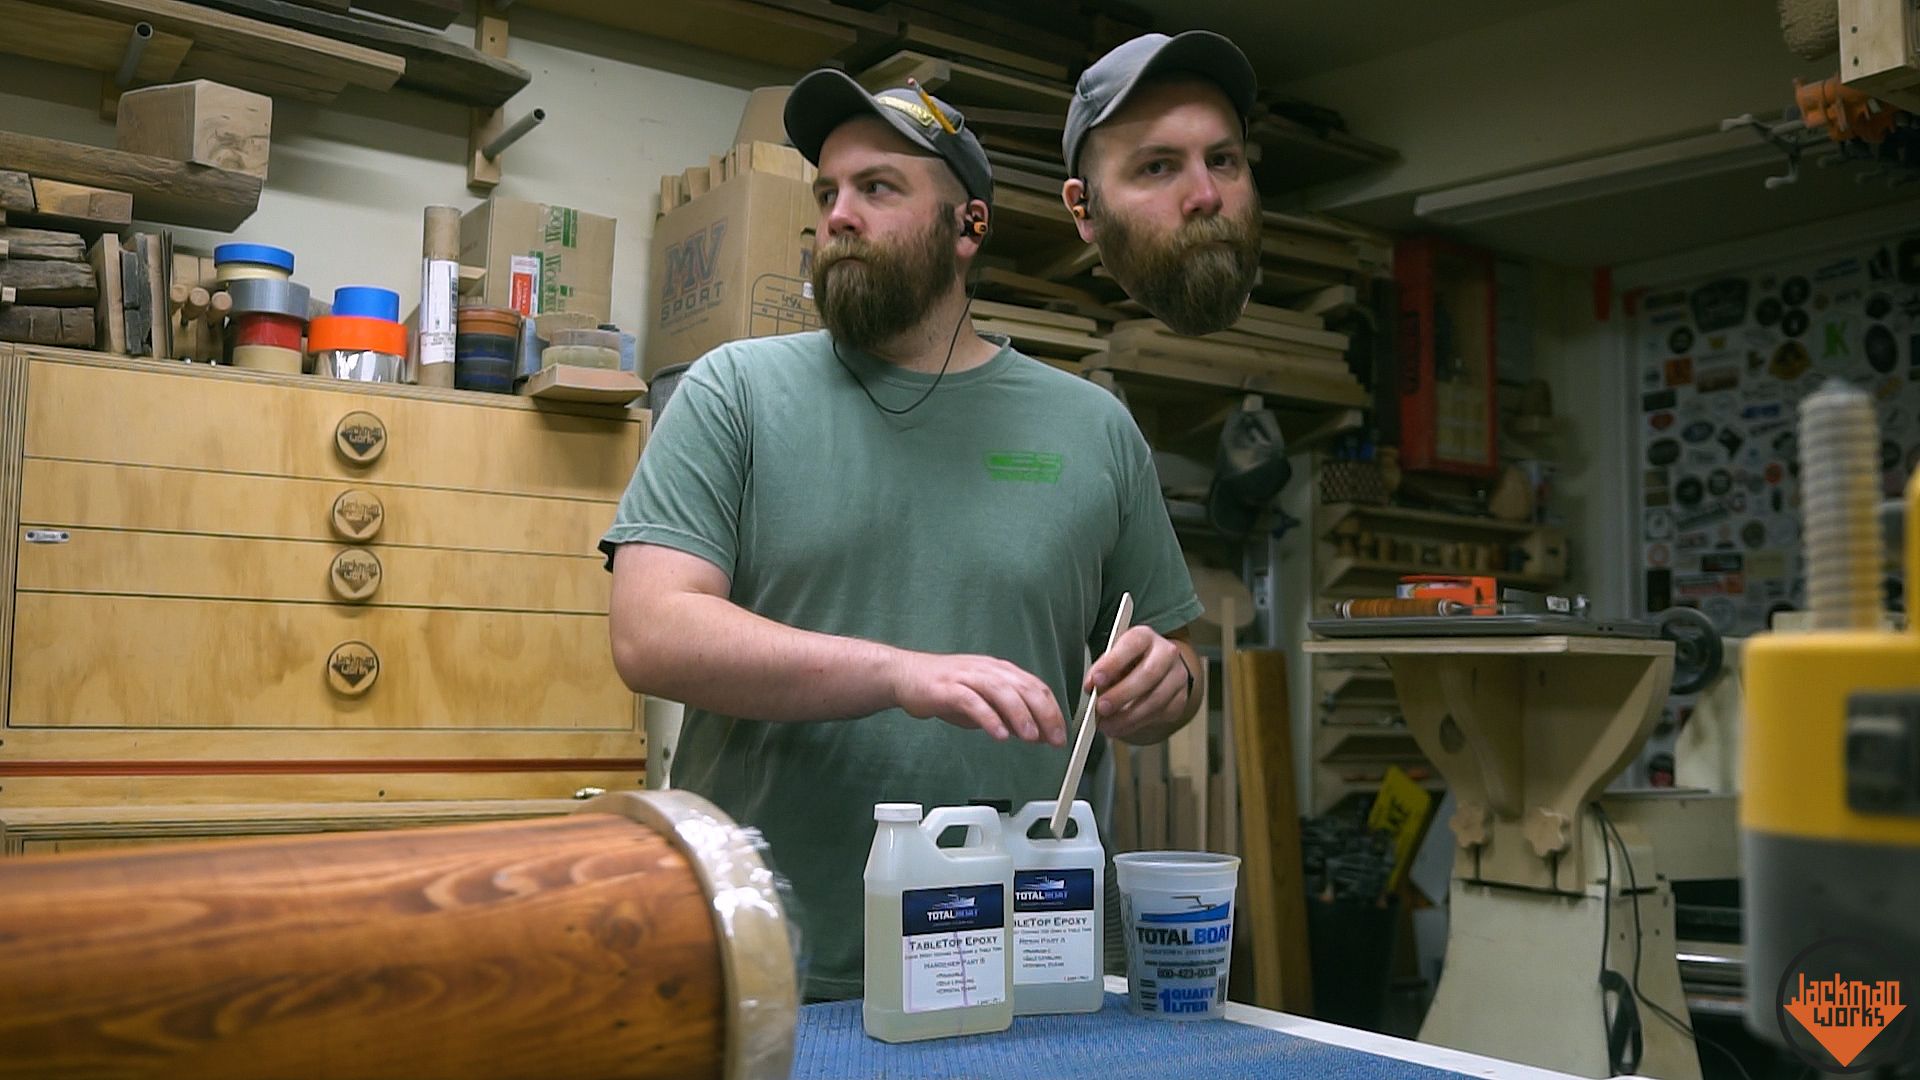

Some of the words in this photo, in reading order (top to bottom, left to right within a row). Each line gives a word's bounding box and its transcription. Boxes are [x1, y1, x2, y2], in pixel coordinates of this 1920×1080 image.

[663, 217, 728, 303] MV
[660, 281, 723, 320] SPORT
[1053, 916, 1087, 927] EPOXY
[965, 936, 998, 947] EPOXY
[1136, 923, 1231, 946] TOTALBOAT
[1171, 986, 1216, 1000] QUART
[1172, 1001, 1209, 1014] LITER
